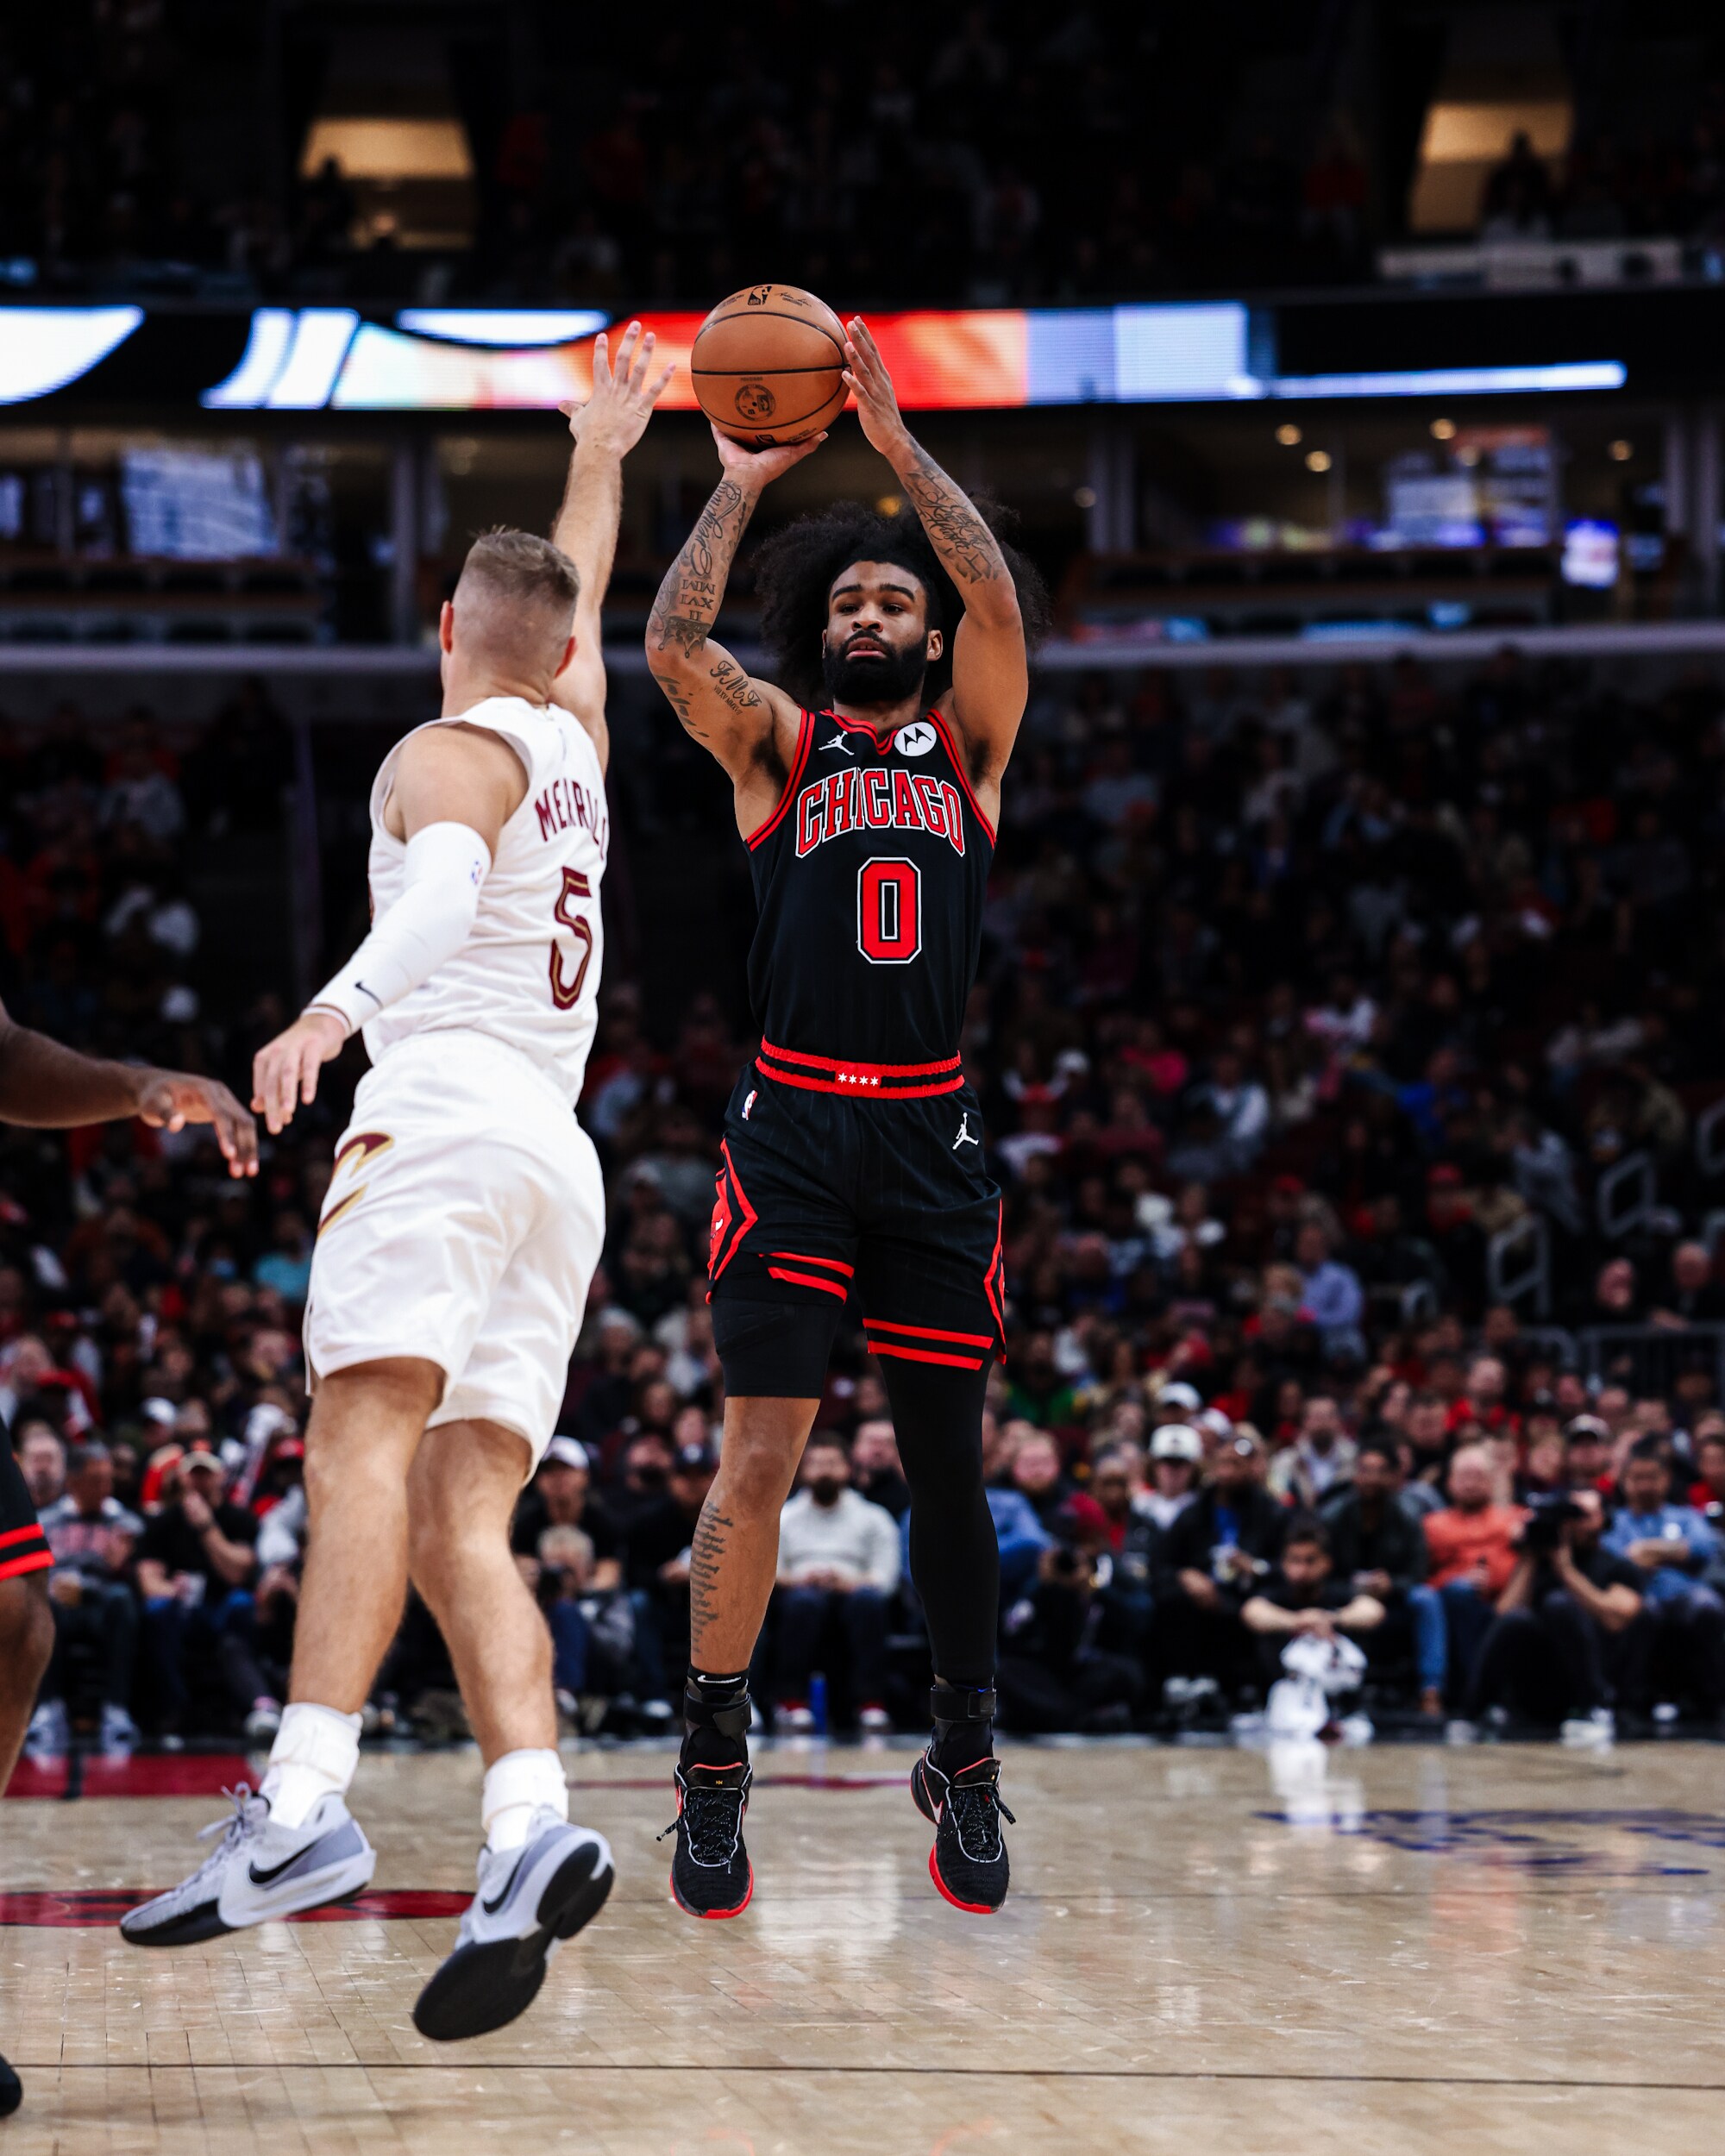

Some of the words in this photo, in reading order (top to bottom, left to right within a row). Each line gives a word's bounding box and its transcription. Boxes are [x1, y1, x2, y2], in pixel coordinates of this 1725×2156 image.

[795, 766, 966, 859] CHICAGO
[549, 866, 593, 1010] 5
[856, 856, 922, 964] 0
